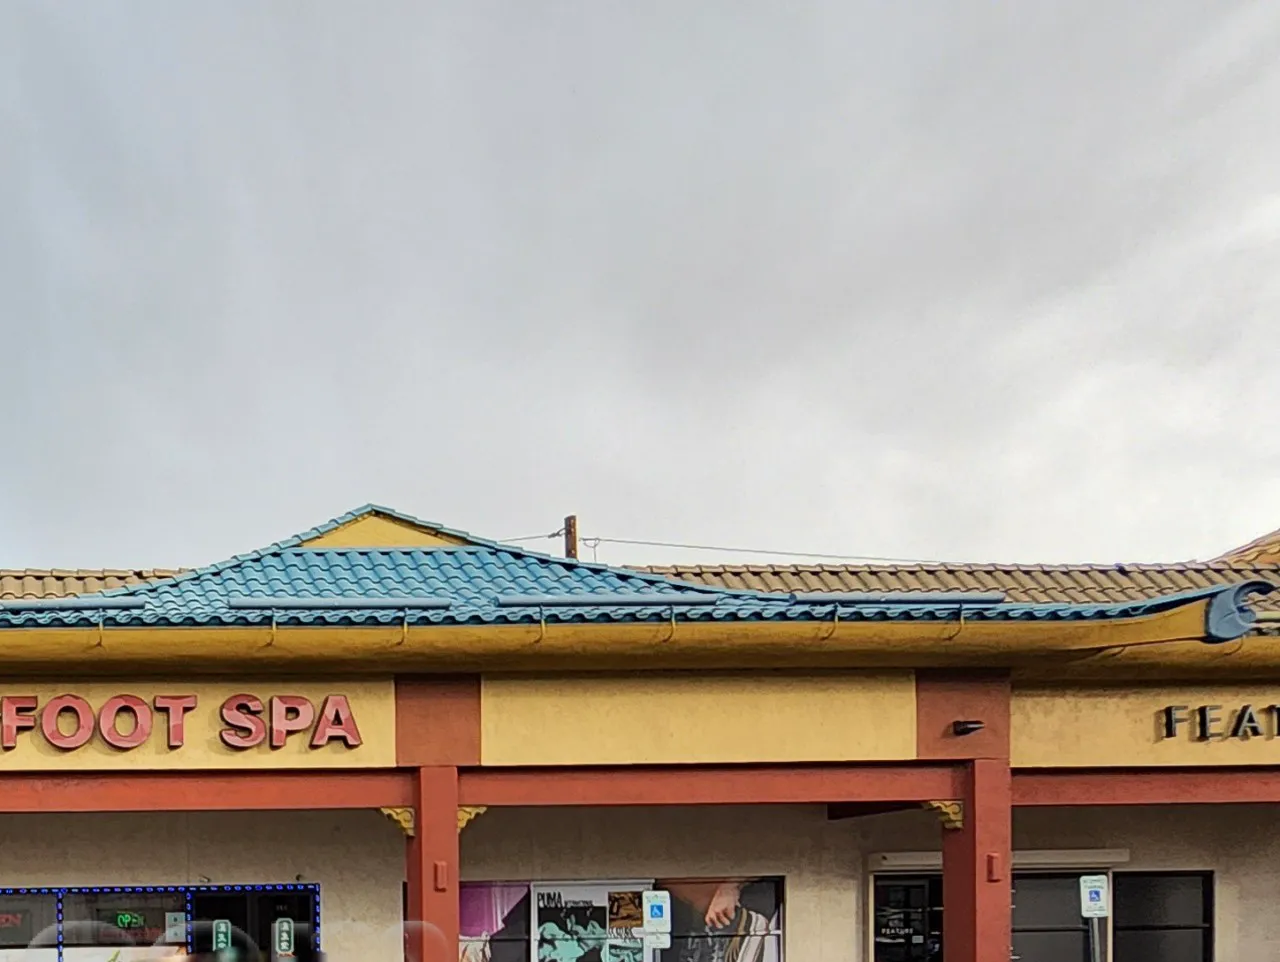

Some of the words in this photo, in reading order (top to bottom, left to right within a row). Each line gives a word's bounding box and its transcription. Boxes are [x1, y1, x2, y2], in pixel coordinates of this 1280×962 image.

[1, 694, 198, 749] FOOT
[219, 693, 362, 749] SPA
[117, 914, 145, 928] OPEN
